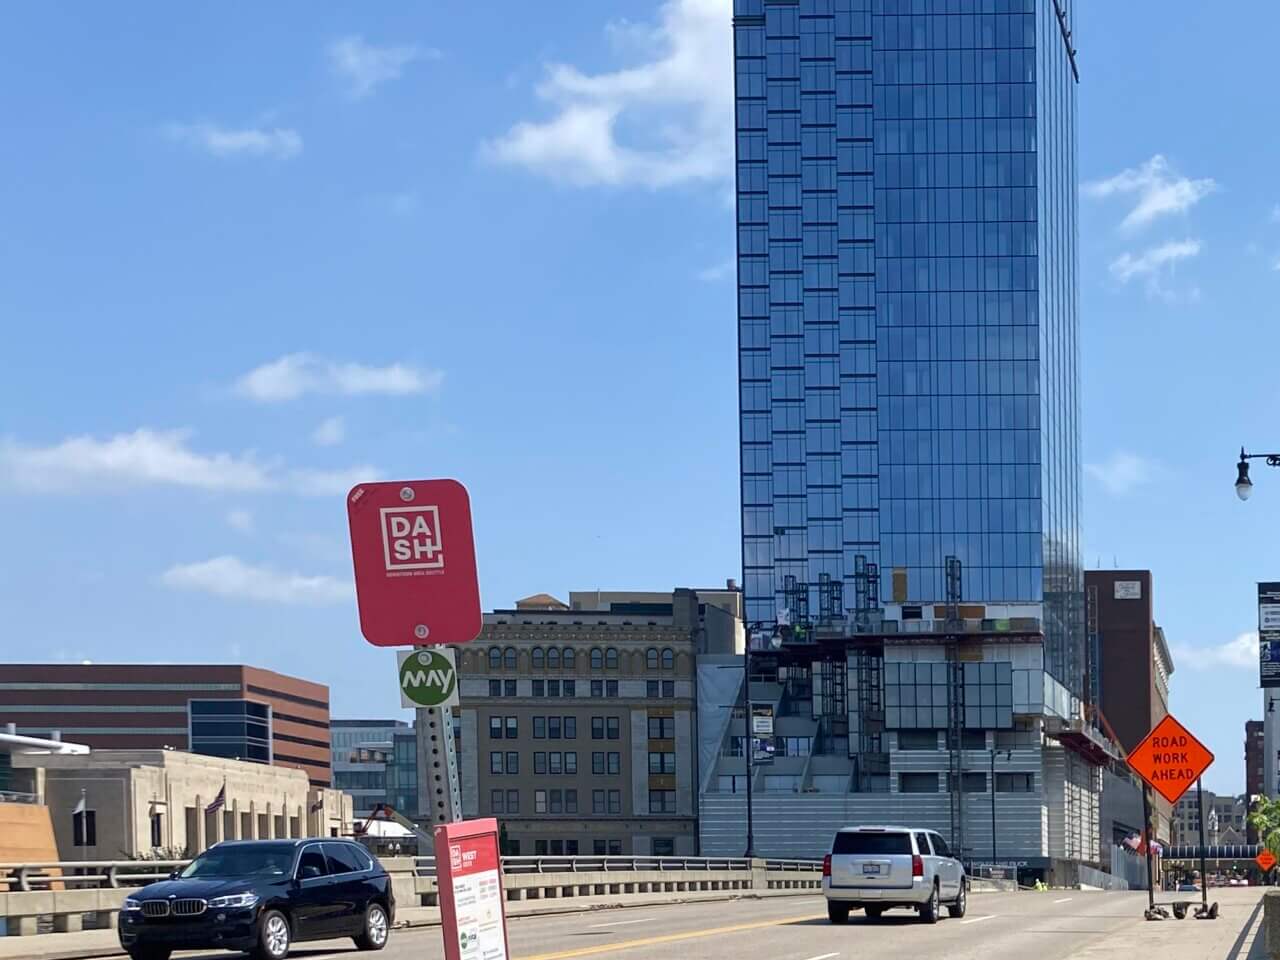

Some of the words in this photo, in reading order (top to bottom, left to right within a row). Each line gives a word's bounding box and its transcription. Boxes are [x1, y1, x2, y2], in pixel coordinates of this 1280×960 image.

[1152, 736, 1188, 748] ROAD
[1152, 752, 1188, 764] WORK
[1151, 768, 1194, 781] AHEAD
